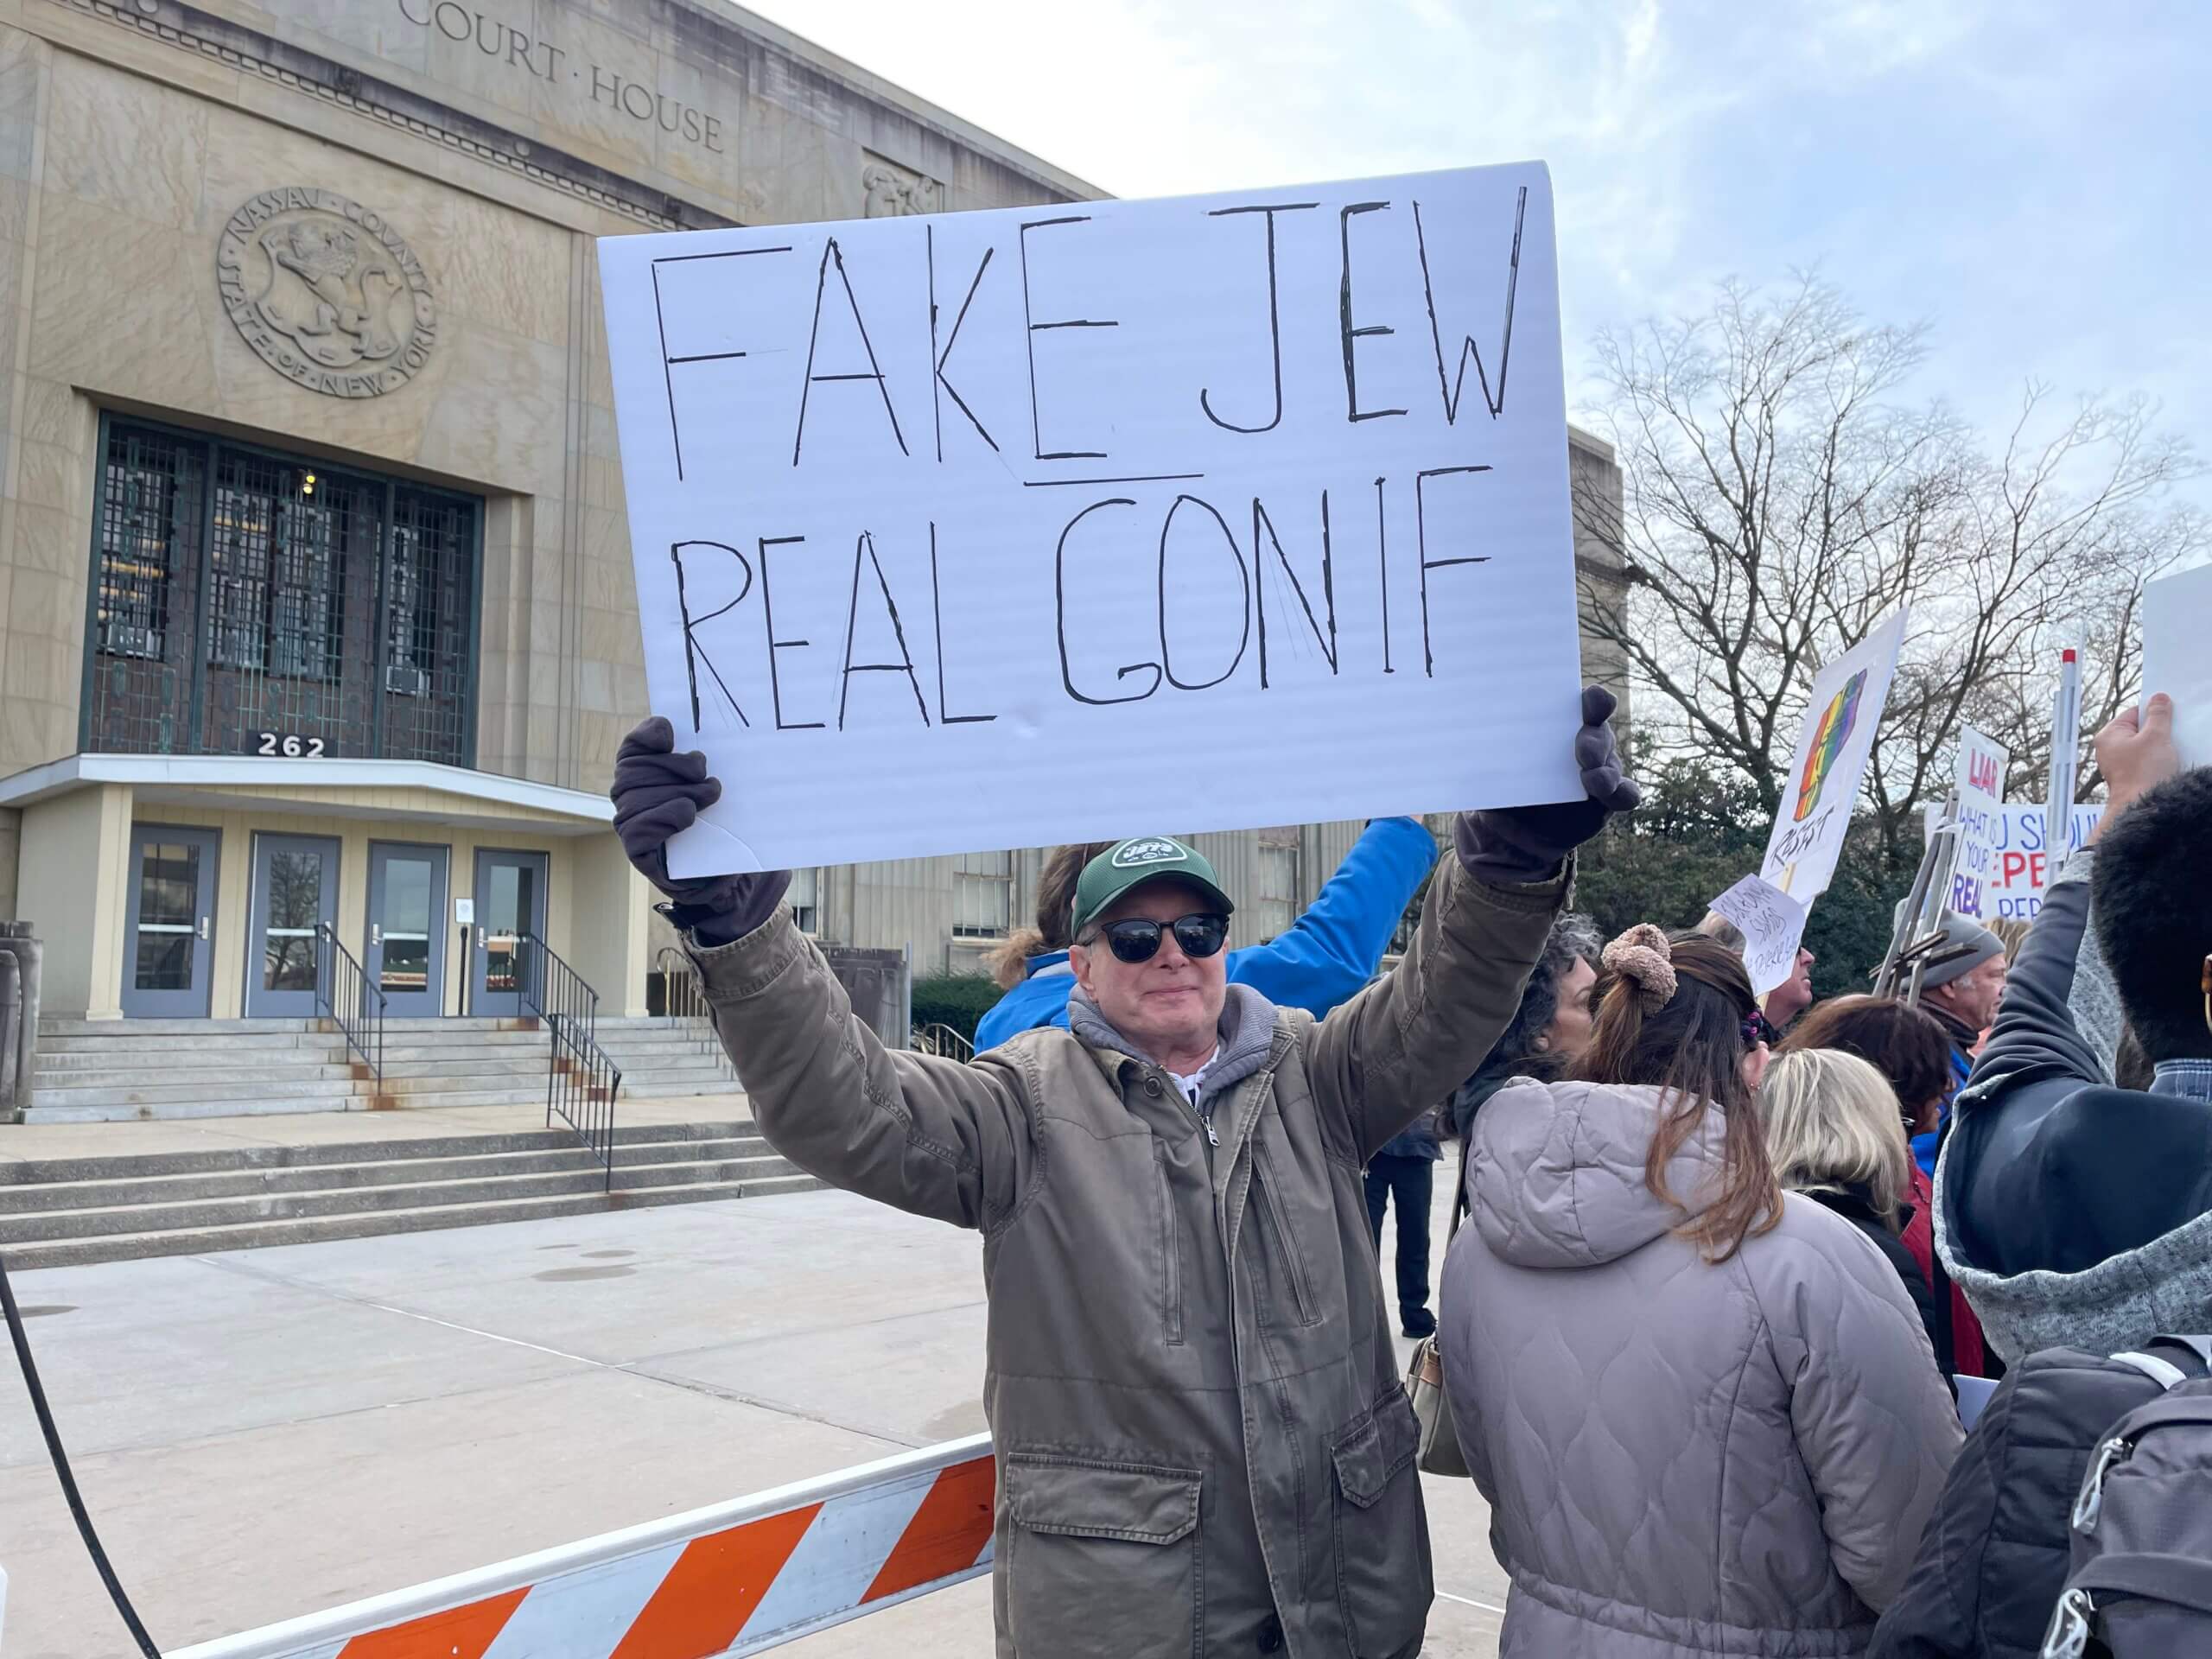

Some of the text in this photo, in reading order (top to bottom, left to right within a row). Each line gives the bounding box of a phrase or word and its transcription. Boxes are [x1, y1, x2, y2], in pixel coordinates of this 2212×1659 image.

[398, 0, 725, 155] COURT HOUSE
[226, 186, 320, 245] NASSAU
[218, 260, 436, 396] STATE OF NEW YORK
[652, 186, 1528, 481] FAKE JEW
[671, 465, 1494, 734] REAL GONIF
[257, 732, 325, 758] 262
[1968, 747, 1999, 798] LIAR
[1959, 803, 1988, 838] WHAT
[1967, 840, 1990, 876] YOUR
[1951, 872, 1984, 920] REAL
